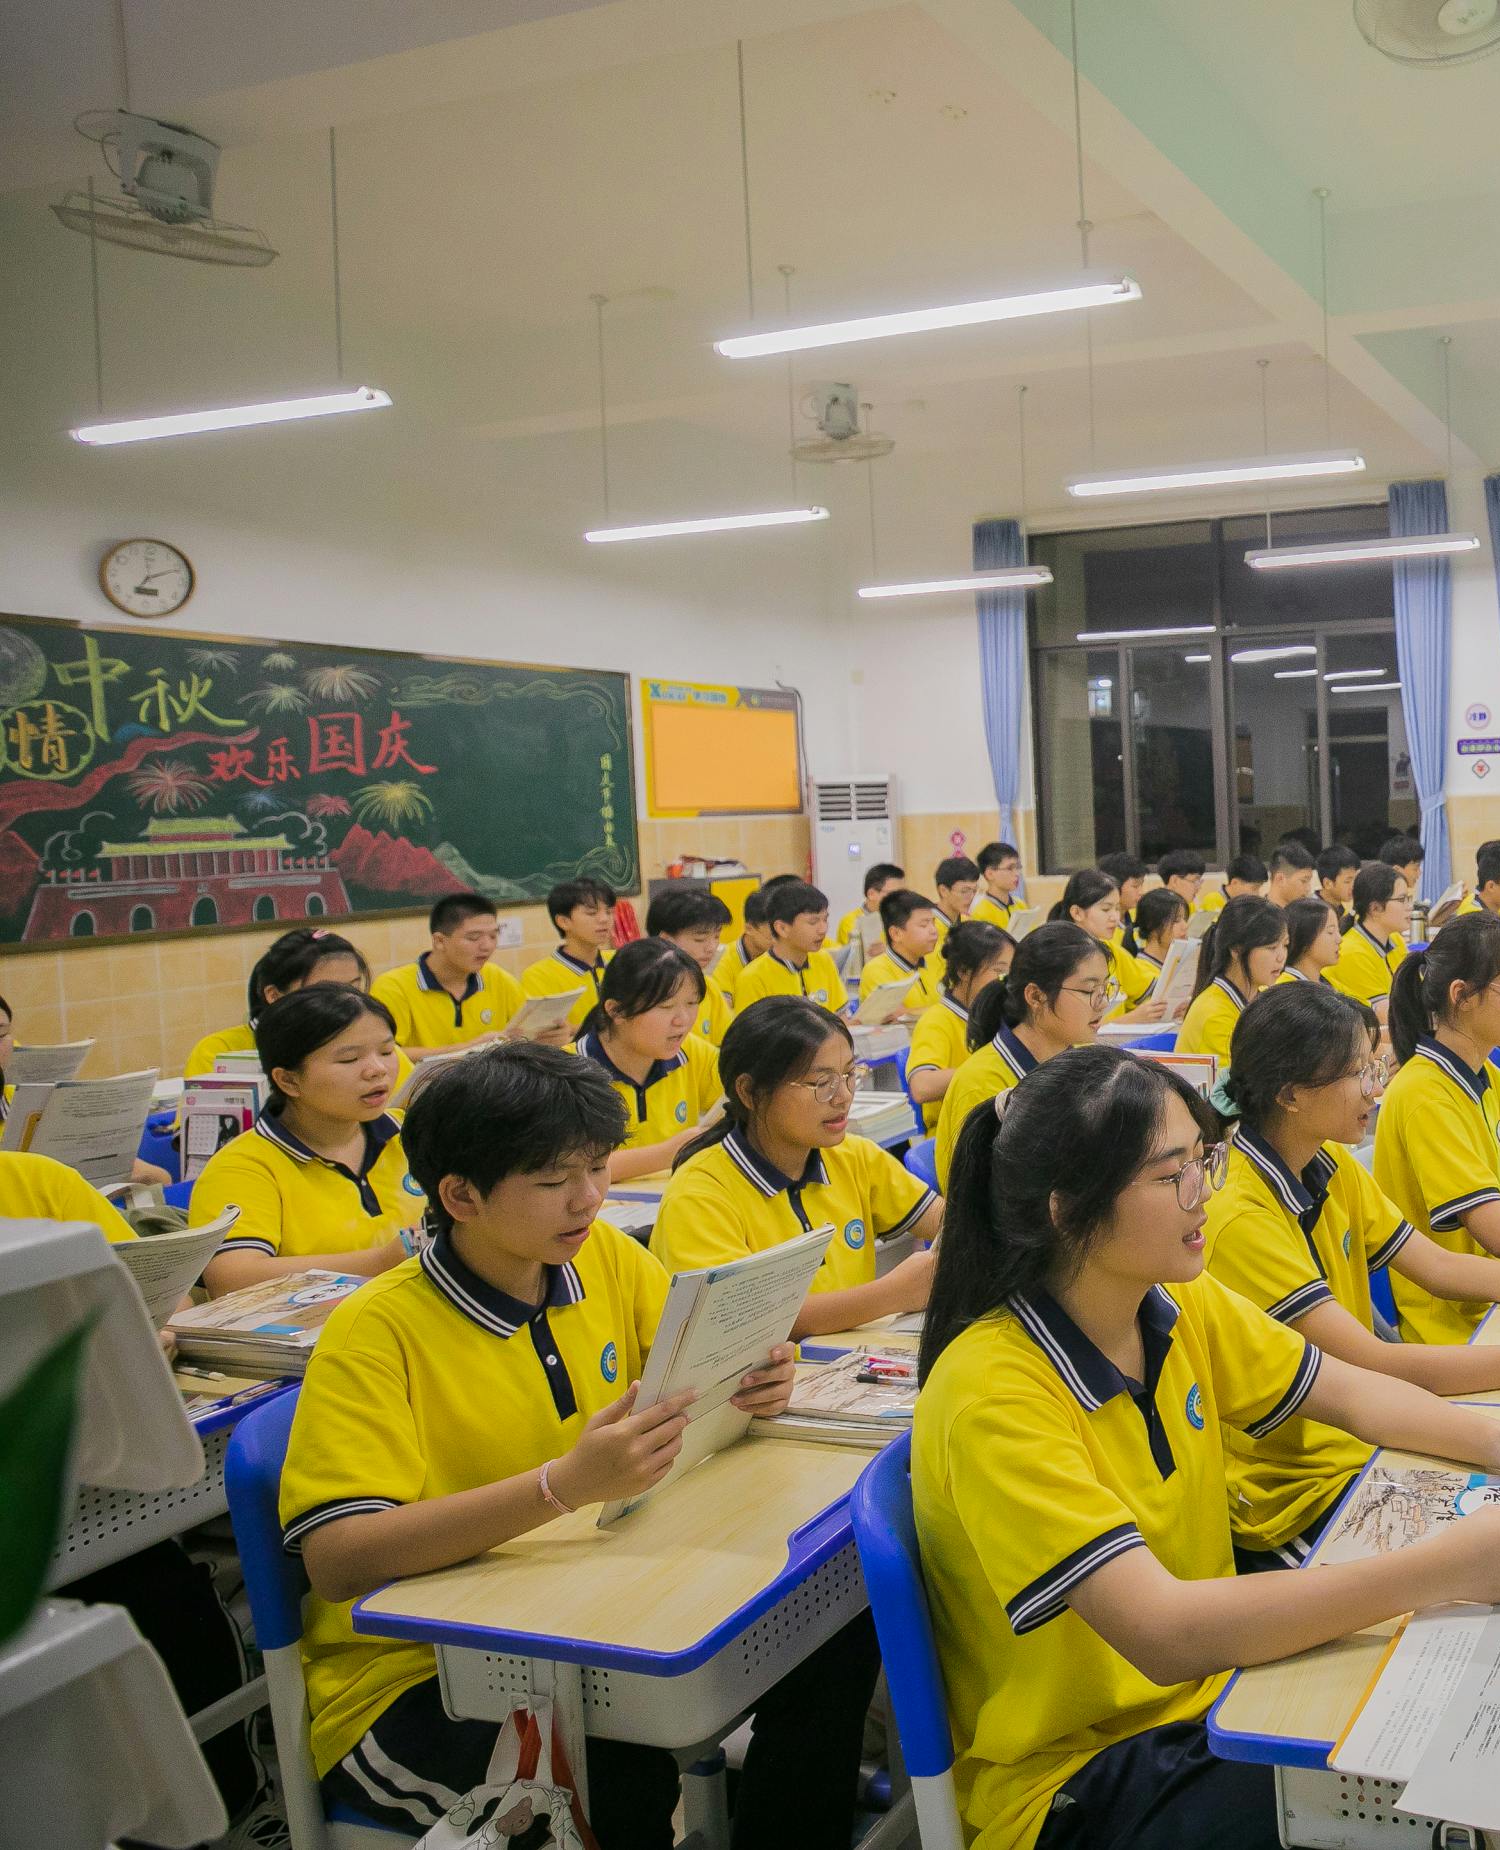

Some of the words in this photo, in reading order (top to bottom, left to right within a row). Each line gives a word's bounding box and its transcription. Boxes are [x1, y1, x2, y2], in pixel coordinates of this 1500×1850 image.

[50, 634, 248, 743] 中秋
[8, 704, 77, 772] 情
[206, 711, 438, 786] 欢乐国庆
